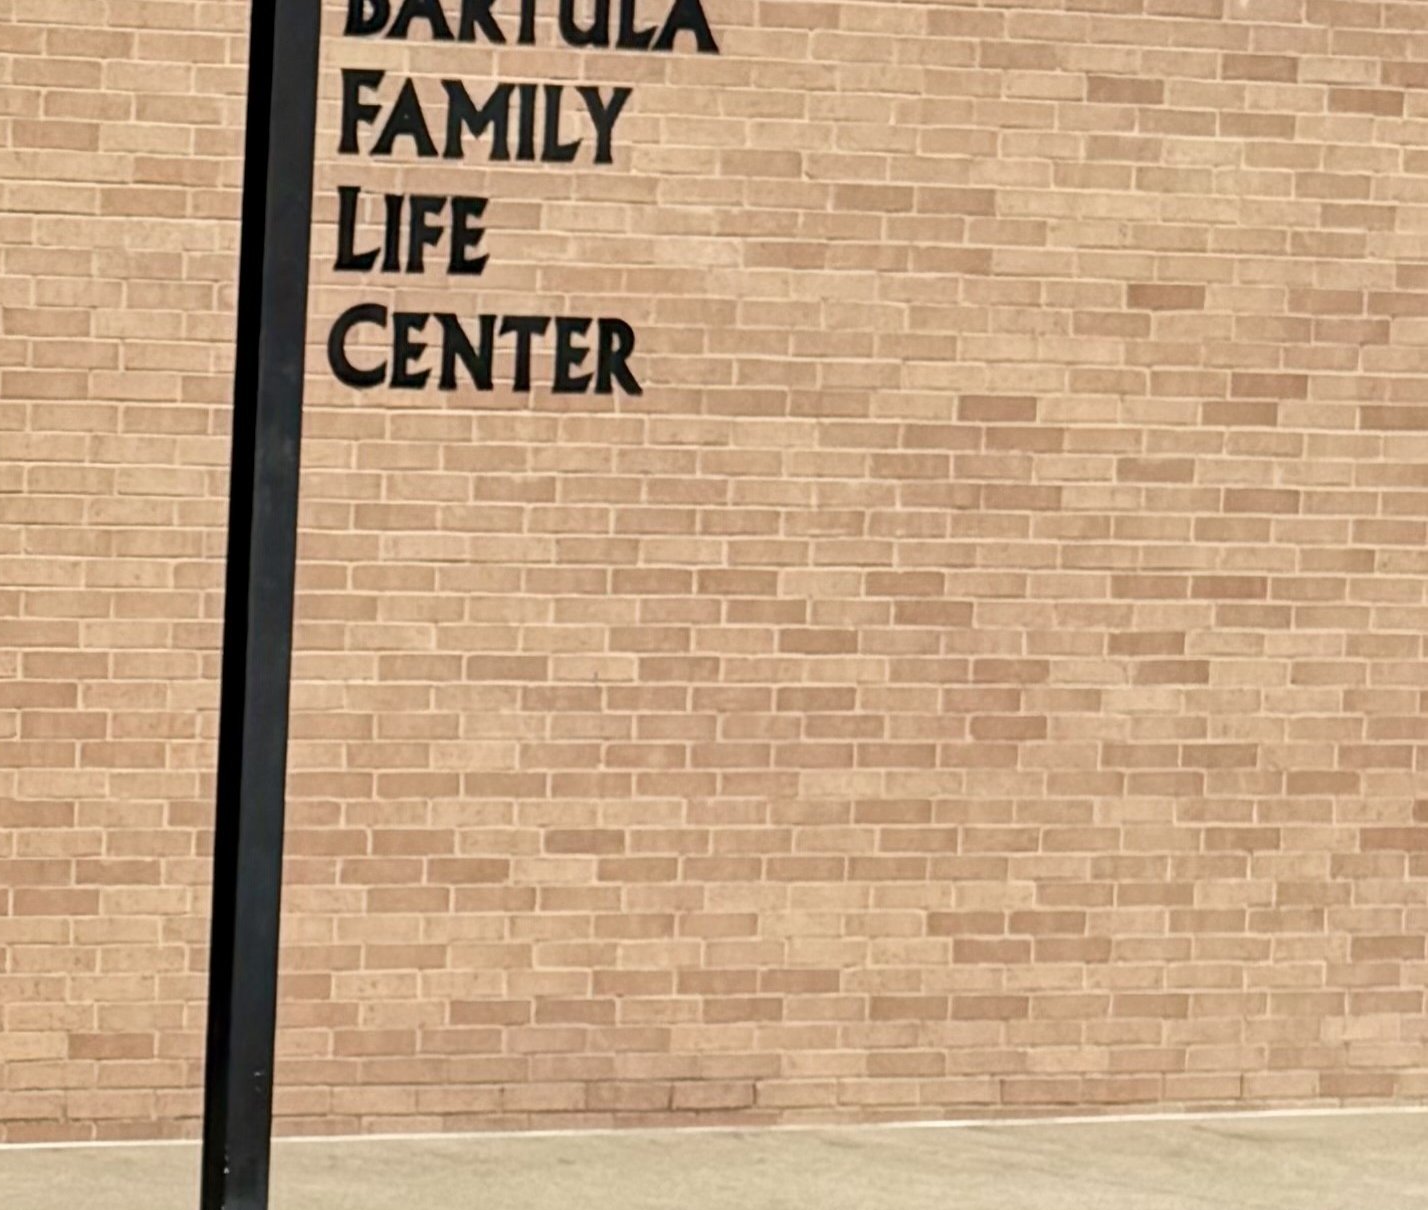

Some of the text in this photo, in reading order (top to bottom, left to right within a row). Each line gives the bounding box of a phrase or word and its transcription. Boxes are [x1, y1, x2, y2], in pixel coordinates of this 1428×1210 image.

[337, 67, 634, 165] FAMILY
[332, 185, 490, 276] LIFE
[326, 302, 644, 396] CENTER
